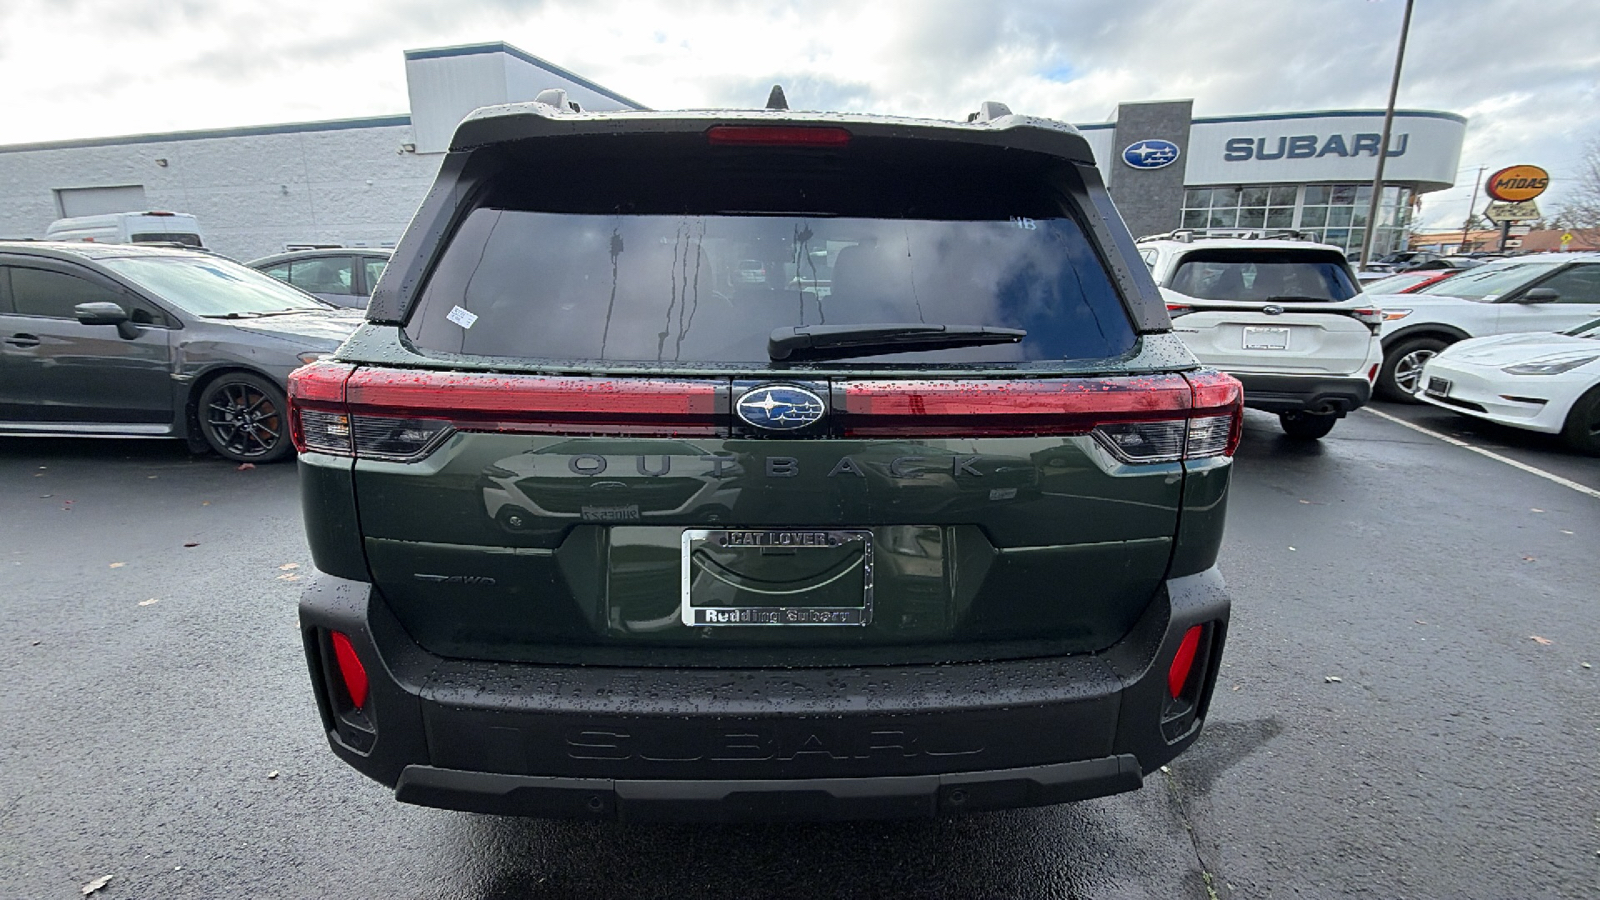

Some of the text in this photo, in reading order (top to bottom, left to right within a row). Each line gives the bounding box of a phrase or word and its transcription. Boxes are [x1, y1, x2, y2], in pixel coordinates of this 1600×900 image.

[1224, 133, 1408, 161] SUBARU
[1496, 178, 1548, 189] MIDAS
[568, 454, 983, 477] OUTBACK
[731, 532, 826, 545] CAT LOVER
[705, 609, 780, 623] Redding
